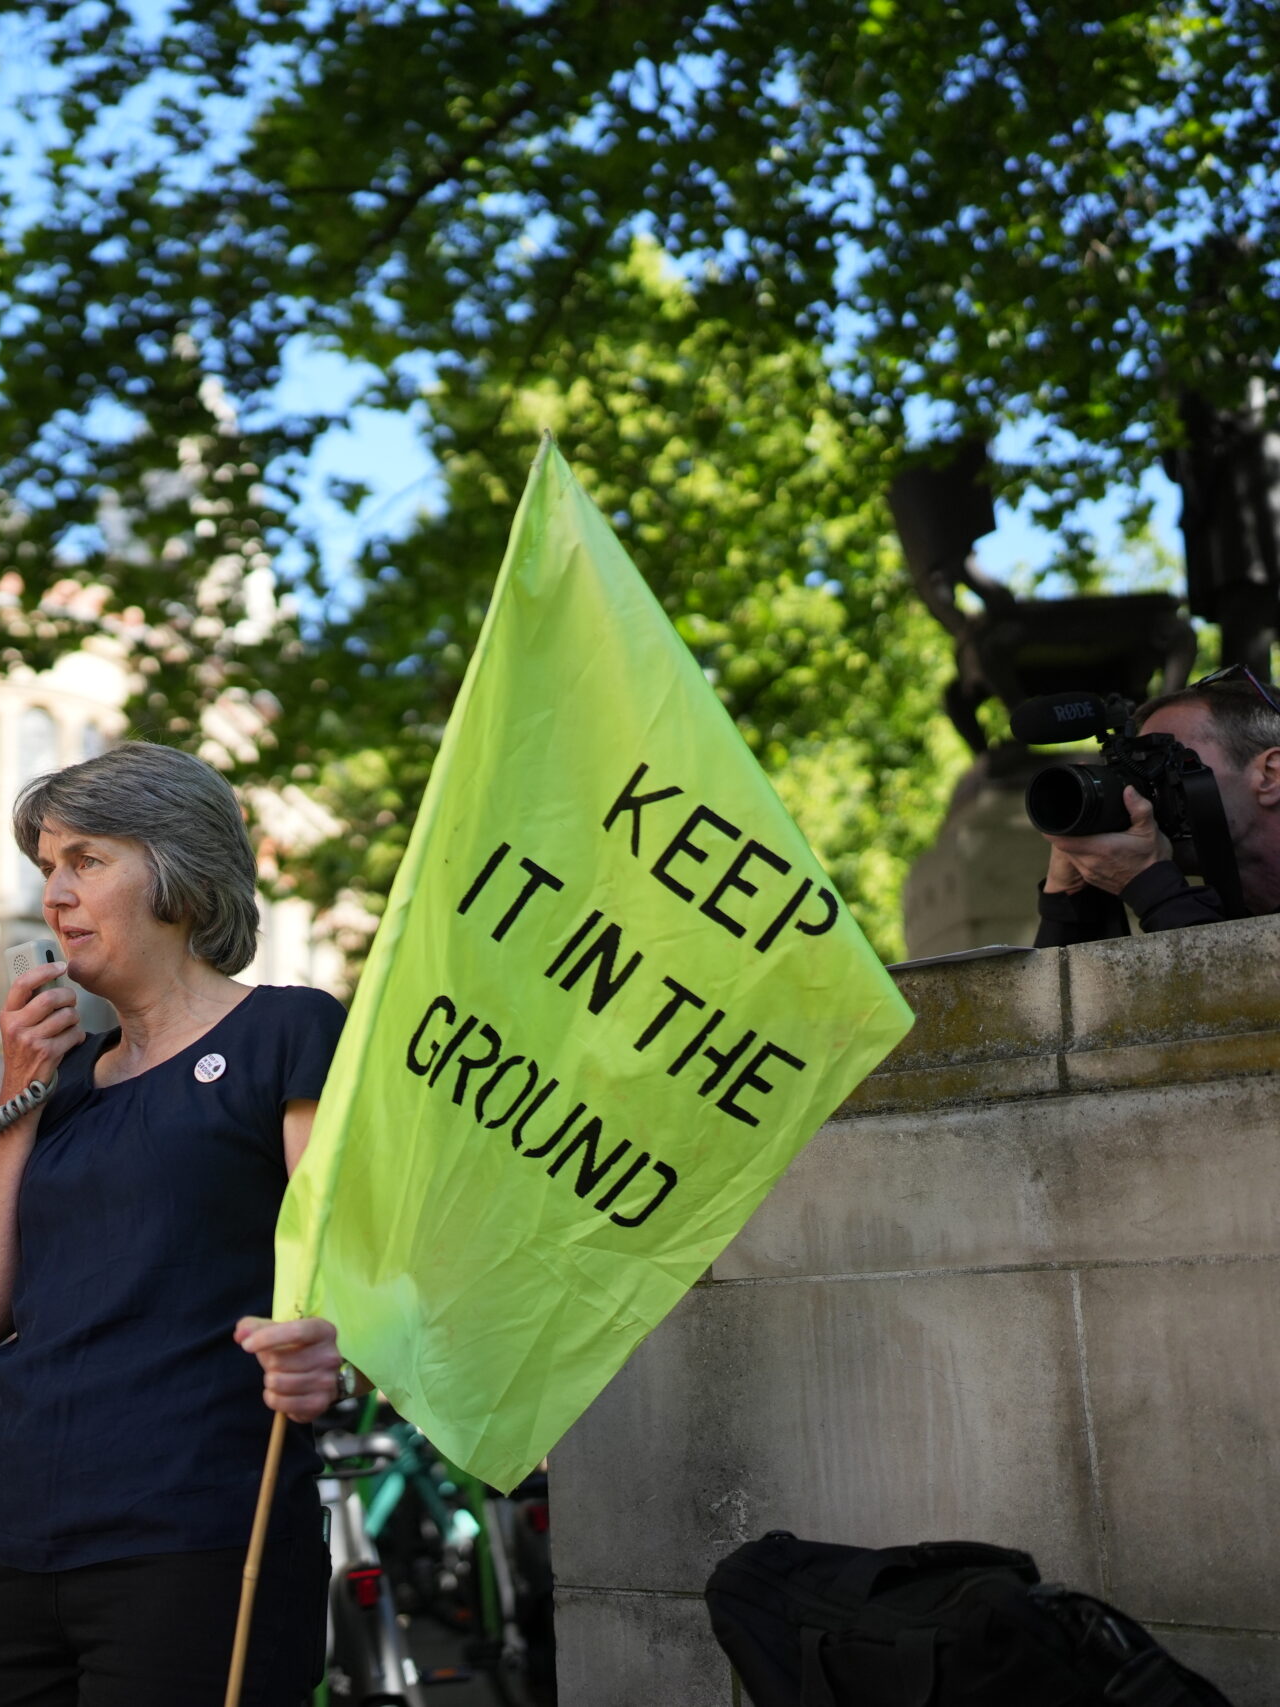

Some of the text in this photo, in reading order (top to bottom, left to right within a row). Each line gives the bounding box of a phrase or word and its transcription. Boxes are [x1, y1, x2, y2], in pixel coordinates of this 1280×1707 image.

[602, 762, 839, 954] KEEP
[456, 841, 807, 1128] IT IN THE
[406, 995, 678, 1228] GROUND
